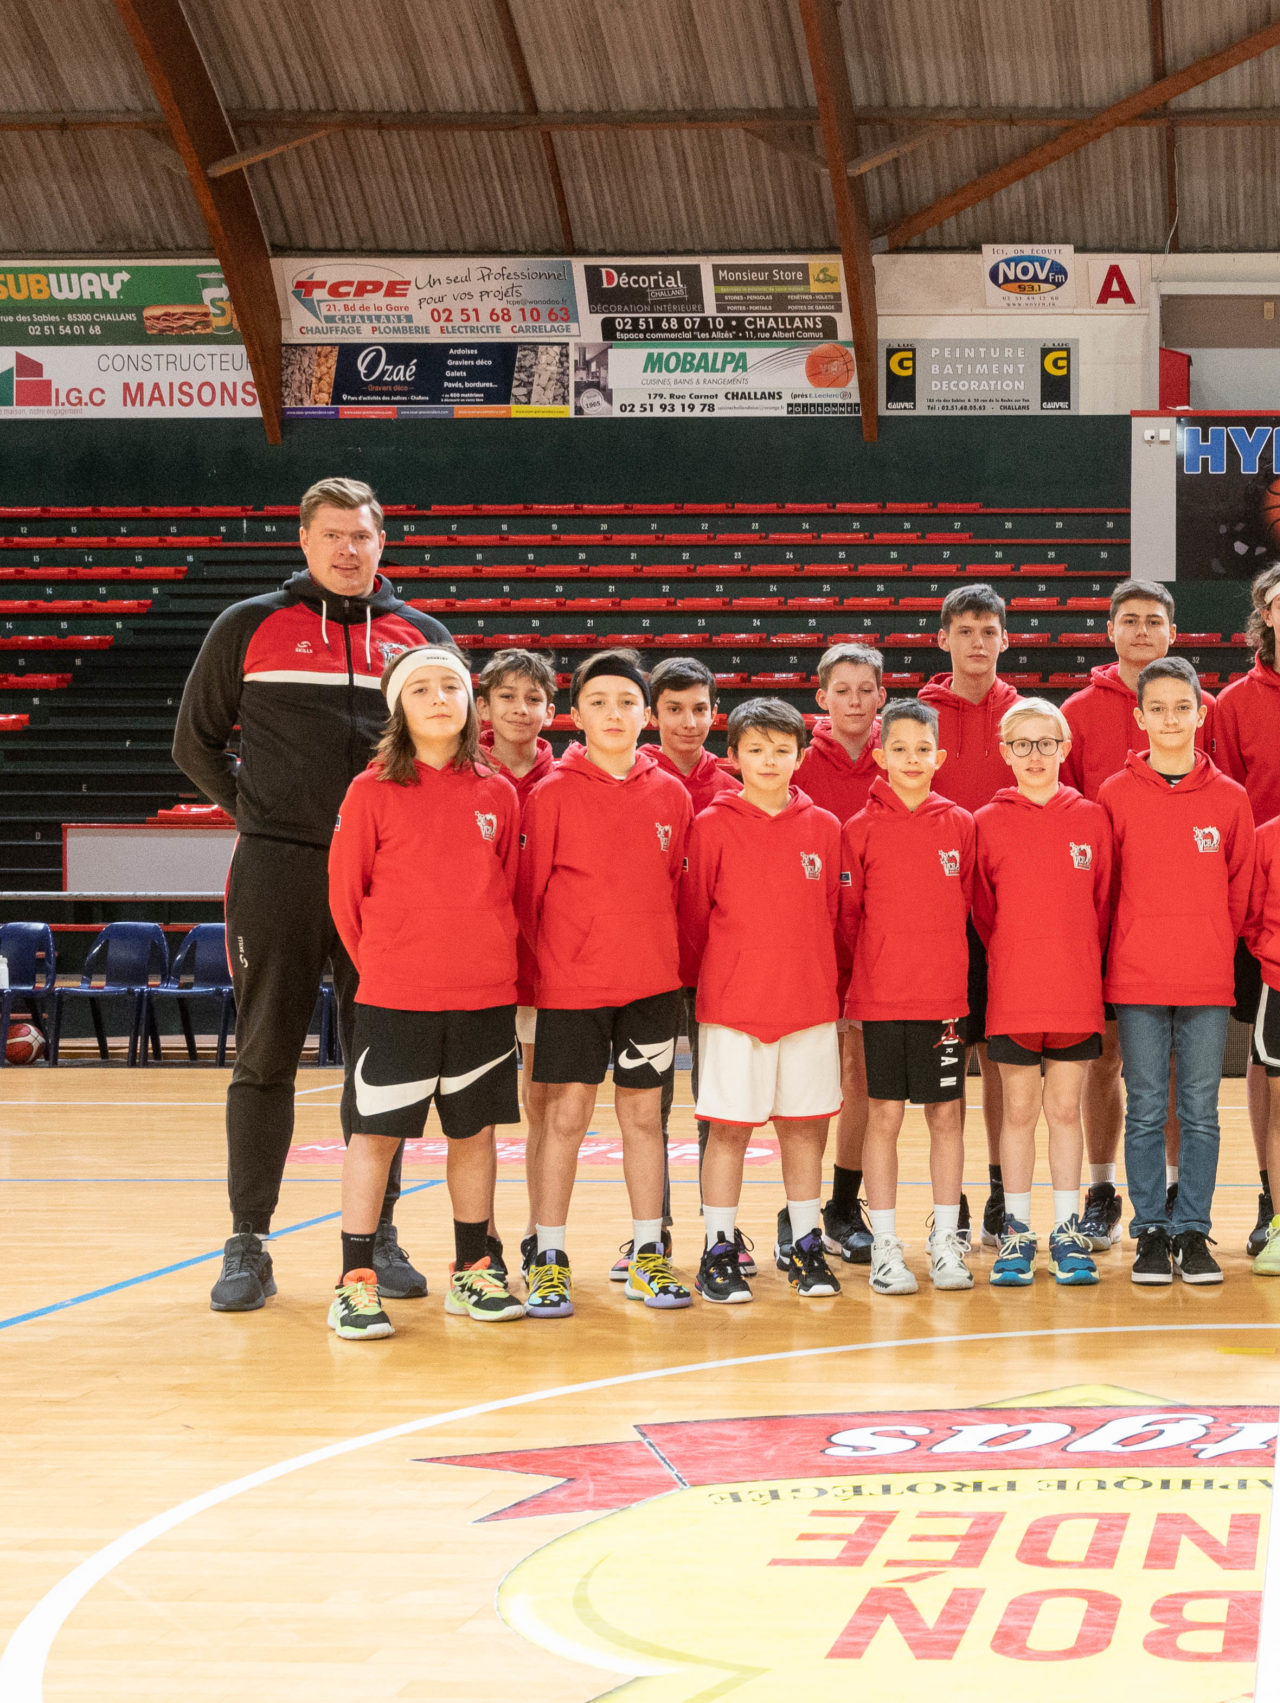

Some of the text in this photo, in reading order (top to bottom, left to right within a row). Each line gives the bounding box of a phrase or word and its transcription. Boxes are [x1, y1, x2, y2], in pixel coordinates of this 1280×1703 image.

[1030, 246, 1063, 255] ÉCOUTE
[719, 269, 803, 281] Monsieur Store
[998, 259, 1053, 284] NOV
[415, 265, 568, 290] Un seul Professionnel
[599, 267, 684, 289] Décorial
[294, 280, 412, 298] TCPE
[1017, 284, 1041, 292] 93.1
[1096, 264, 1136, 305] A
[418, 283, 524, 310] pour vos projets
[650, 288, 685, 298] CHALLANS
[343, 303, 410, 312] Bd de la Gare
[590, 302, 703, 313] DÉCORATION INTÉRIEURE
[16, 313, 137, 322] des Sables 85300 CHALLANS
[335, 315, 407, 323] CHALLANS
[430, 306, 571, 323] 02 51 68 10 63
[615, 317, 823, 330] 02 51 68 07 10 CHALLANS
[28, 325, 102, 335] 02 51 54 01 68
[299, 324, 572, 335] CHAUFFAGE PLOMBERIE ELECTRICITE CARRELAGE
[616, 331, 644, 340] Espace
[645, 331, 692, 339] commercial
[771, 330, 795, 338] Albert
[796, 330, 824, 338] Camus
[931, 347, 1025, 358] PEINTURE
[357, 345, 418, 382] Ozaé
[642, 351, 748, 374] MOBALPA
[889, 350, 913, 377] G
[1043, 350, 1068, 377] G
[931, 364, 1025, 375] BATIMENT
[443, 381, 464, 389] Pavés,
[673, 378, 694, 386] BAINS
[702, 377, 749, 386] RANGEMENTS
[931, 380, 1025, 391] DECORATION
[54, 381, 257, 407] I.G.C MAISONS
[724, 391, 783, 400] CHALLANS
[619, 403, 636, 413] 02
[639, 403, 654, 413] 51
[659, 403, 675, 413] 93
[680, 403, 696, 412] 19
[699, 402, 716, 412] 78
[787, 403, 860, 414] POISSONNET
[708, 1480, 1017, 1506] PROTÉGÉE
